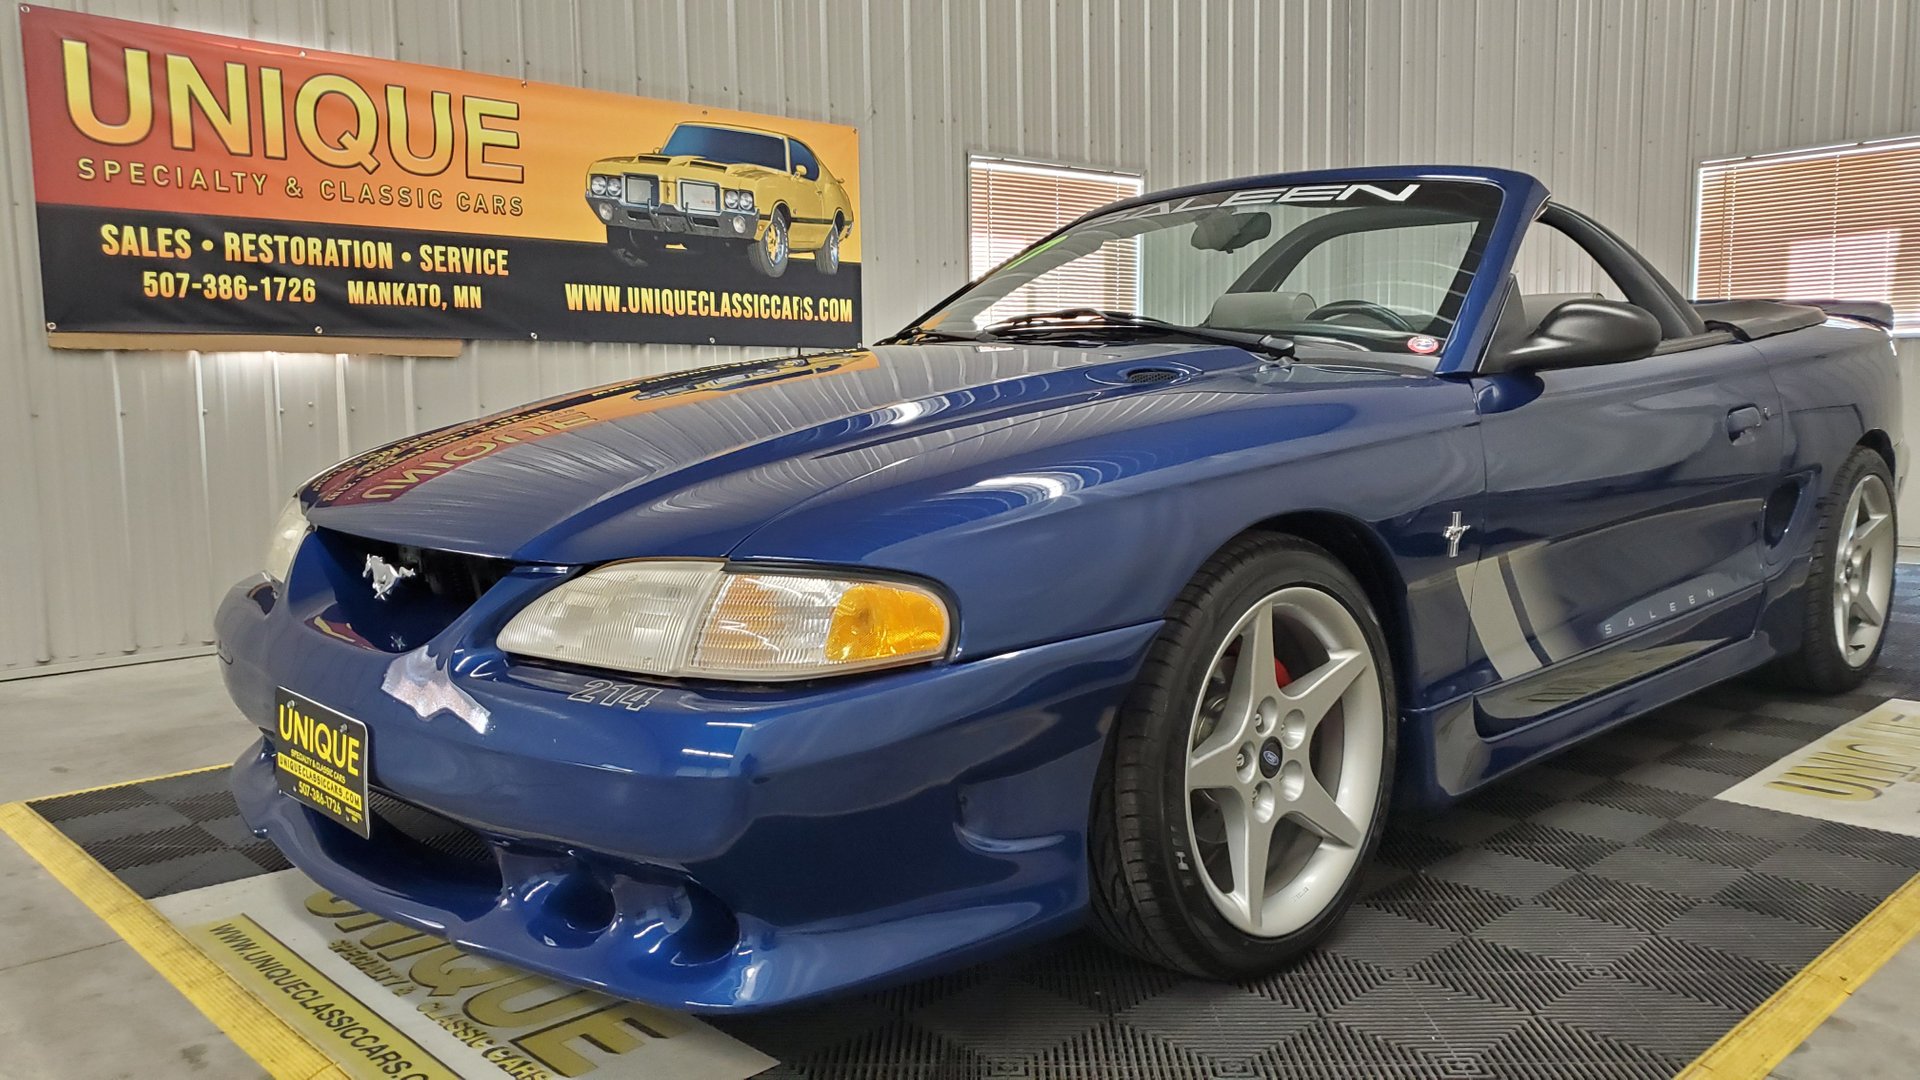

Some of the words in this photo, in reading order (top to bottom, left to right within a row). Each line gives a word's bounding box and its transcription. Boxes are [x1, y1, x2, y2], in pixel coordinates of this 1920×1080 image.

[61, 38, 525, 184] UNIQUE
[77, 157, 267, 195] SPECIALTY
[285, 176, 303, 199] &
[320, 179, 443, 209] CLASSIC
[456, 191, 524, 216] CARS
[100, 223, 192, 260] SALES
[224, 231, 393, 270] RESTORATION
[419, 244, 509, 276] SERVICE
[143, 271, 316, 303] 507-386-1726
[347, 280, 448, 311] MANKATO,
[453, 285, 482, 309] MN
[564, 283, 853, 323] WWW.UNIQUECLASSICCARS.COM
[1604, 587, 1715, 635] SALEEN
[567, 679, 664, 711] 214
[279, 704, 360, 776] UNIQUE
[298, 781, 342, 816] 507-386-1726
